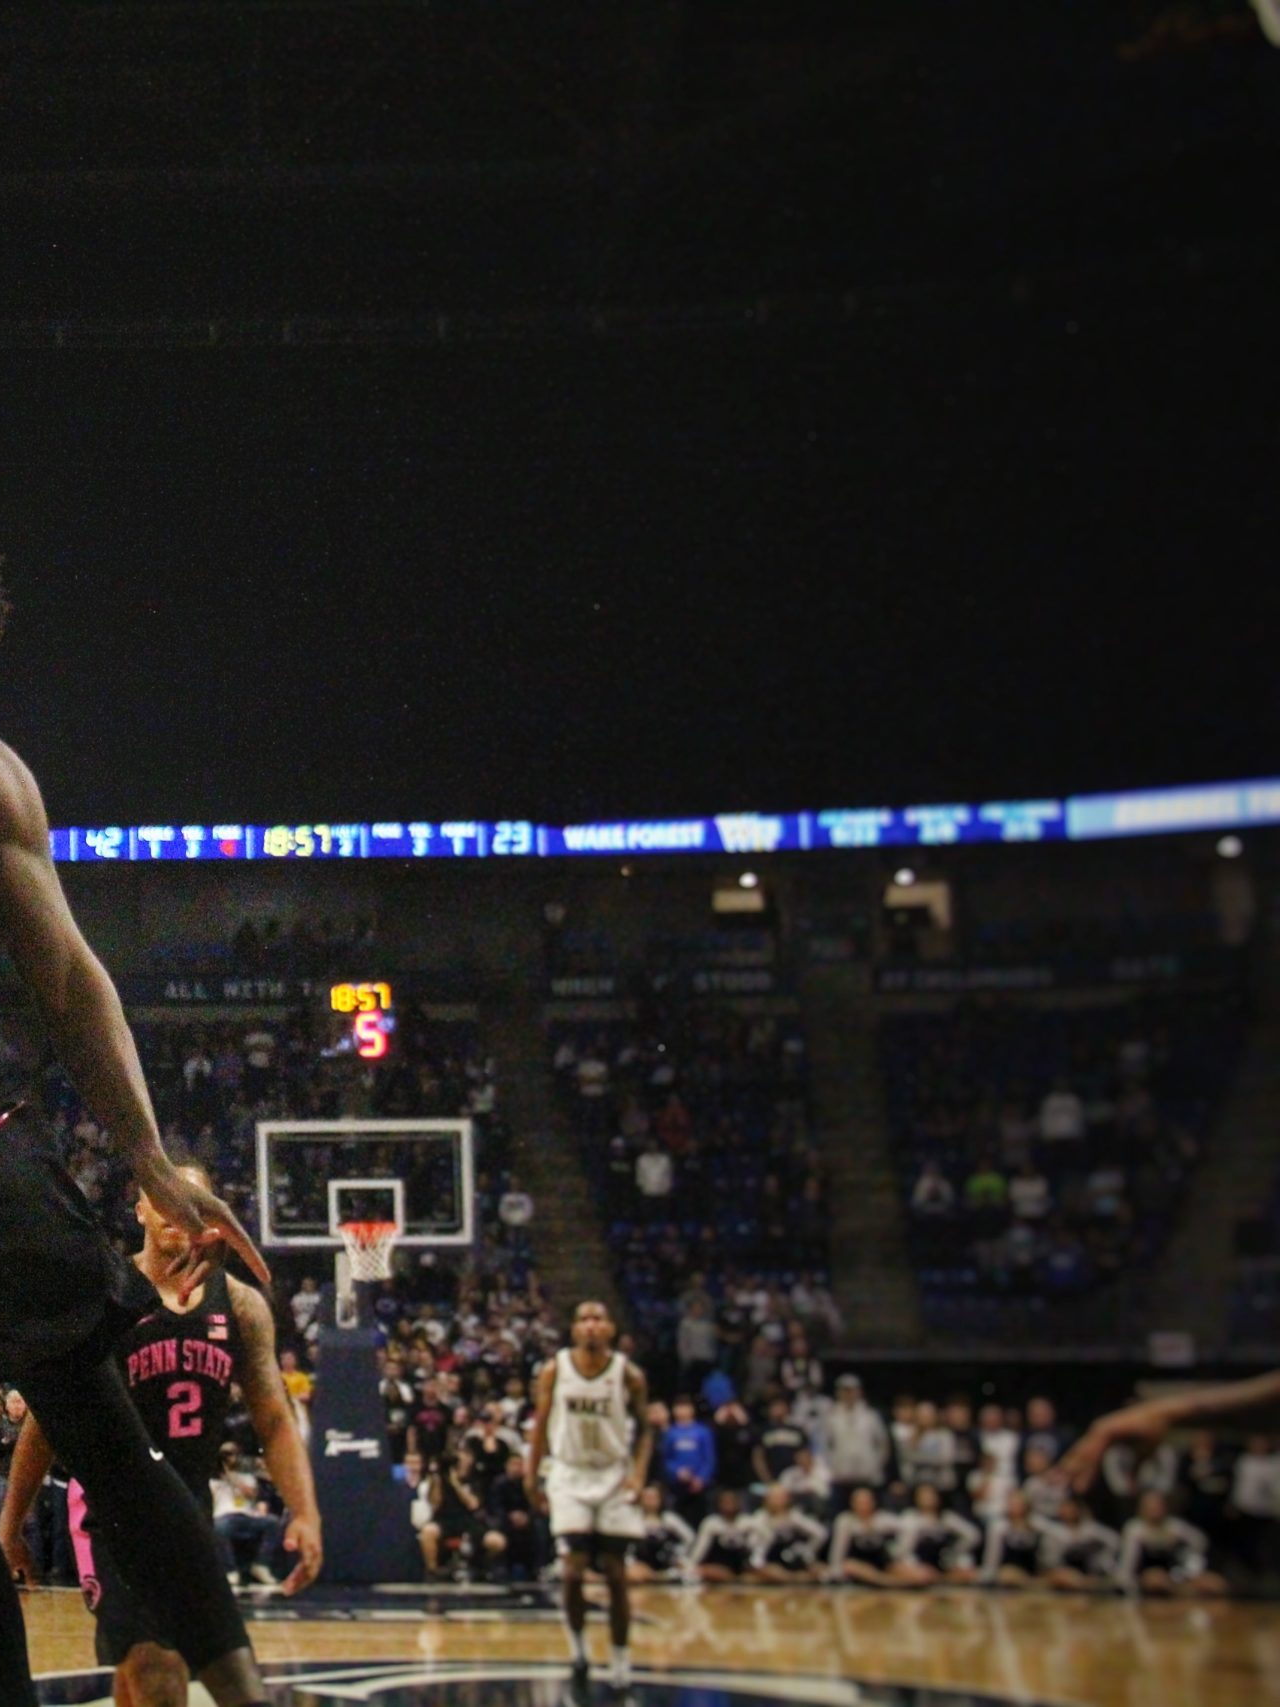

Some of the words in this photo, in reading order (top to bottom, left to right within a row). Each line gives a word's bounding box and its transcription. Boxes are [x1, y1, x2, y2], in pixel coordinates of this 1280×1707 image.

[86, 826, 122, 858] 42
[492, 820, 533, 855] 23
[563, 825, 625, 850] WAKE
[625, 820, 705, 849] FOREST
[354, 1011, 388, 1058] 5
[127, 1338, 177, 1387] PENN
[182, 1338, 233, 1387] STATE
[166, 1381, 202, 1437] 2
